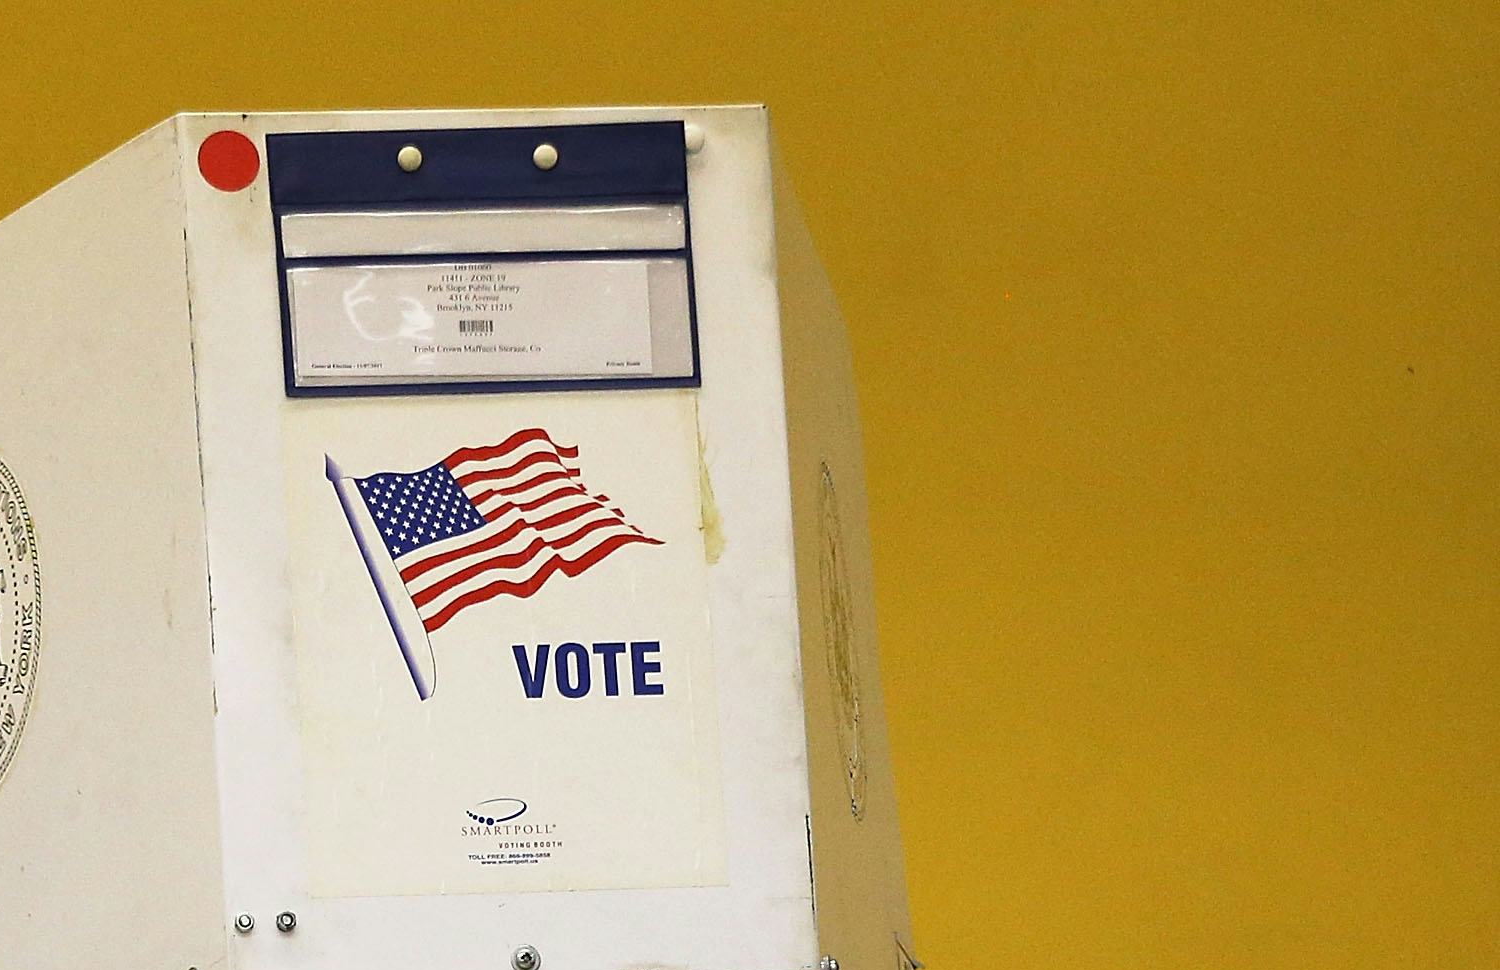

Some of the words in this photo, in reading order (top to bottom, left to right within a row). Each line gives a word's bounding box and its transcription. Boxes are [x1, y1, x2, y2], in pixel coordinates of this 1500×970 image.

[446, 284, 466, 293] Slope
[493, 284, 520, 294] Library
[436, 304, 473, 313] Brooklyn,
[414, 345, 435, 353] Triple
[13, 602, 34, 694] YORK
[512, 642, 664, 698] VOTE
